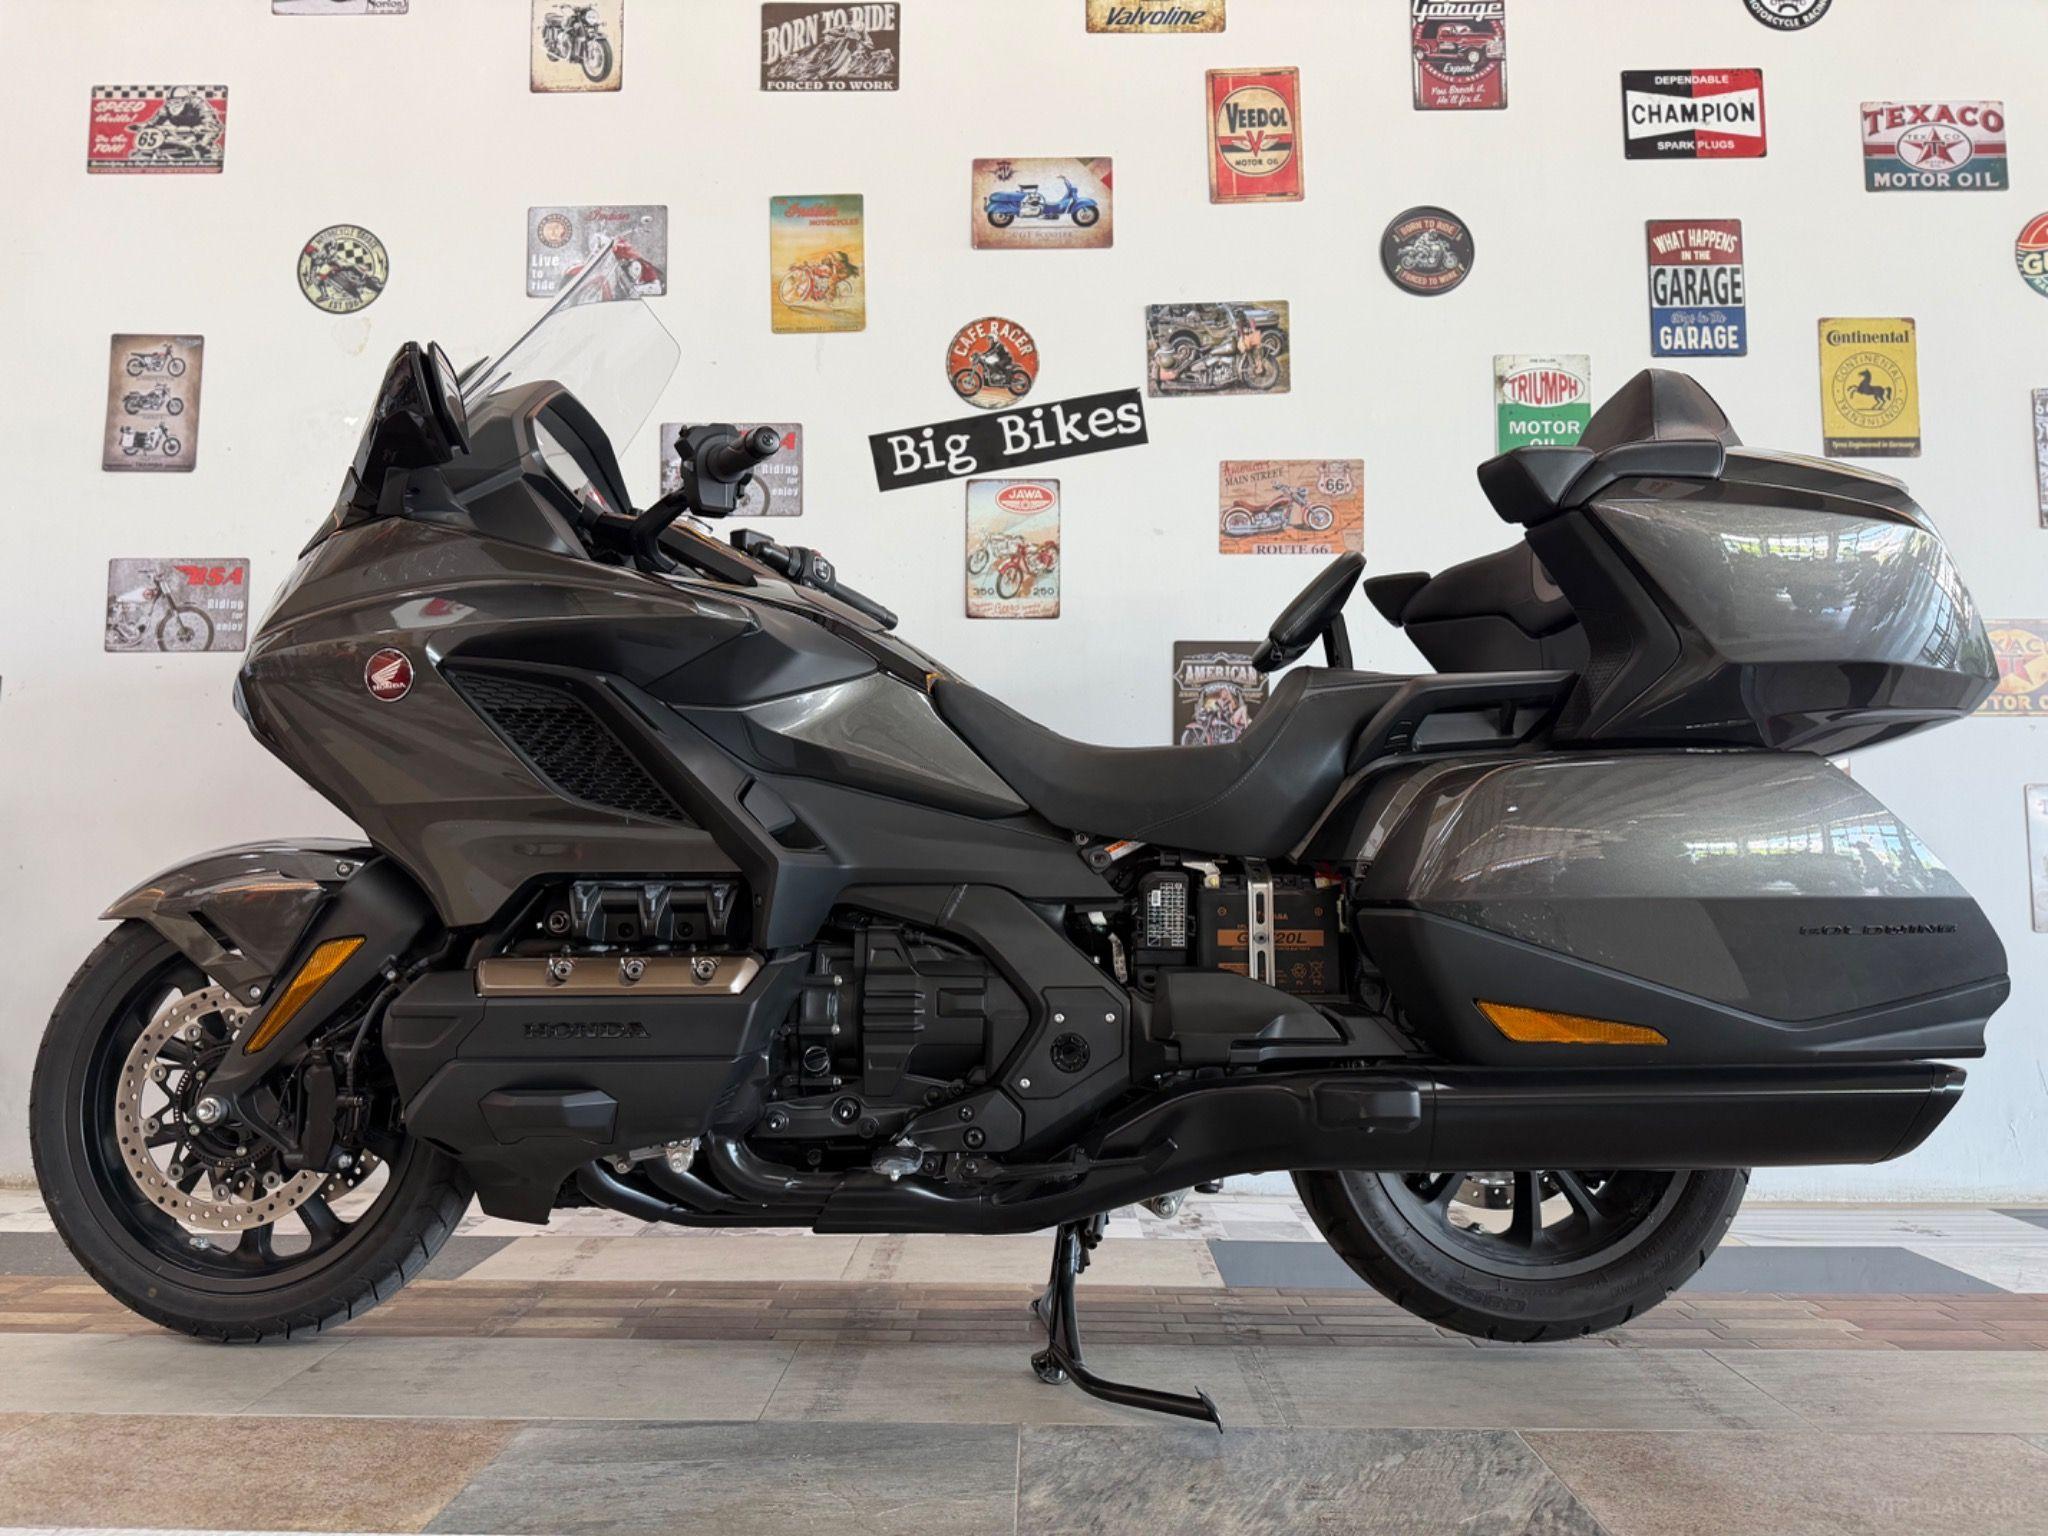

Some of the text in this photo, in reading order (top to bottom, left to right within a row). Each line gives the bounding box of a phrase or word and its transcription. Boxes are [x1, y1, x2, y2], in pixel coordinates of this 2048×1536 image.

[1105, 6, 1207, 25] Valvoline
[762, 4, 897, 64] BORN TO RIDE
[767, 81, 894, 90] FORCED TO WORK
[1654, 75, 1729, 85] DEPENDABLE
[95, 101, 147, 112] SPEED
[1632, 102, 1755, 124] CHAMPION
[1225, 102, 1287, 134] VEEDOL
[1863, 104, 2004, 137] TEXACO
[138, 132, 160, 147] 65
[1657, 140, 1735, 151] SPARK PLUGS
[1873, 173, 2000, 188] MOTOR OIL
[1400, 220, 1423, 236] BORN
[1423, 219, 1437, 231] TO
[1652, 229, 1738, 255] WHAT HAPPENS
[531, 254, 561, 267] Live
[1681, 250, 1711, 261] IN THE
[532, 270, 544, 280] to
[531, 280, 557, 291] ride
[1653, 266, 1743, 306] GARAGE
[953, 320, 1034, 357] CAFE RACER
[1660, 325, 1740, 350] GARAGE
[1826, 330, 1909, 347] Continental
[1835, 353, 1904, 384] CONTINENTAL
[1508, 370, 1579, 405] TRIUMPH
[1509, 421, 1581, 435] MOTOR
[888, 403, 1142, 476] Big Bikes
[762, 463, 799, 476] Riding
[1225, 467, 1284, 487] MAIN STREET
[786, 475, 799, 485] for
[1326, 478, 1345, 491] 66
[771, 486, 799, 498] enjoy
[1008, 489, 1043, 499] JAWA
[1257, 545, 1329, 554] ROUTE 66
[180, 565, 244, 587] BSA
[207, 599, 244, 610] Riding
[215, 622, 244, 632] enjoy
[1183, 664, 1257, 686] AMERICAN
[371, 682, 407, 691] HONDA
[1236, 932, 1308, 945] G20L
[521, 1021, 651, 1040] HONDA
